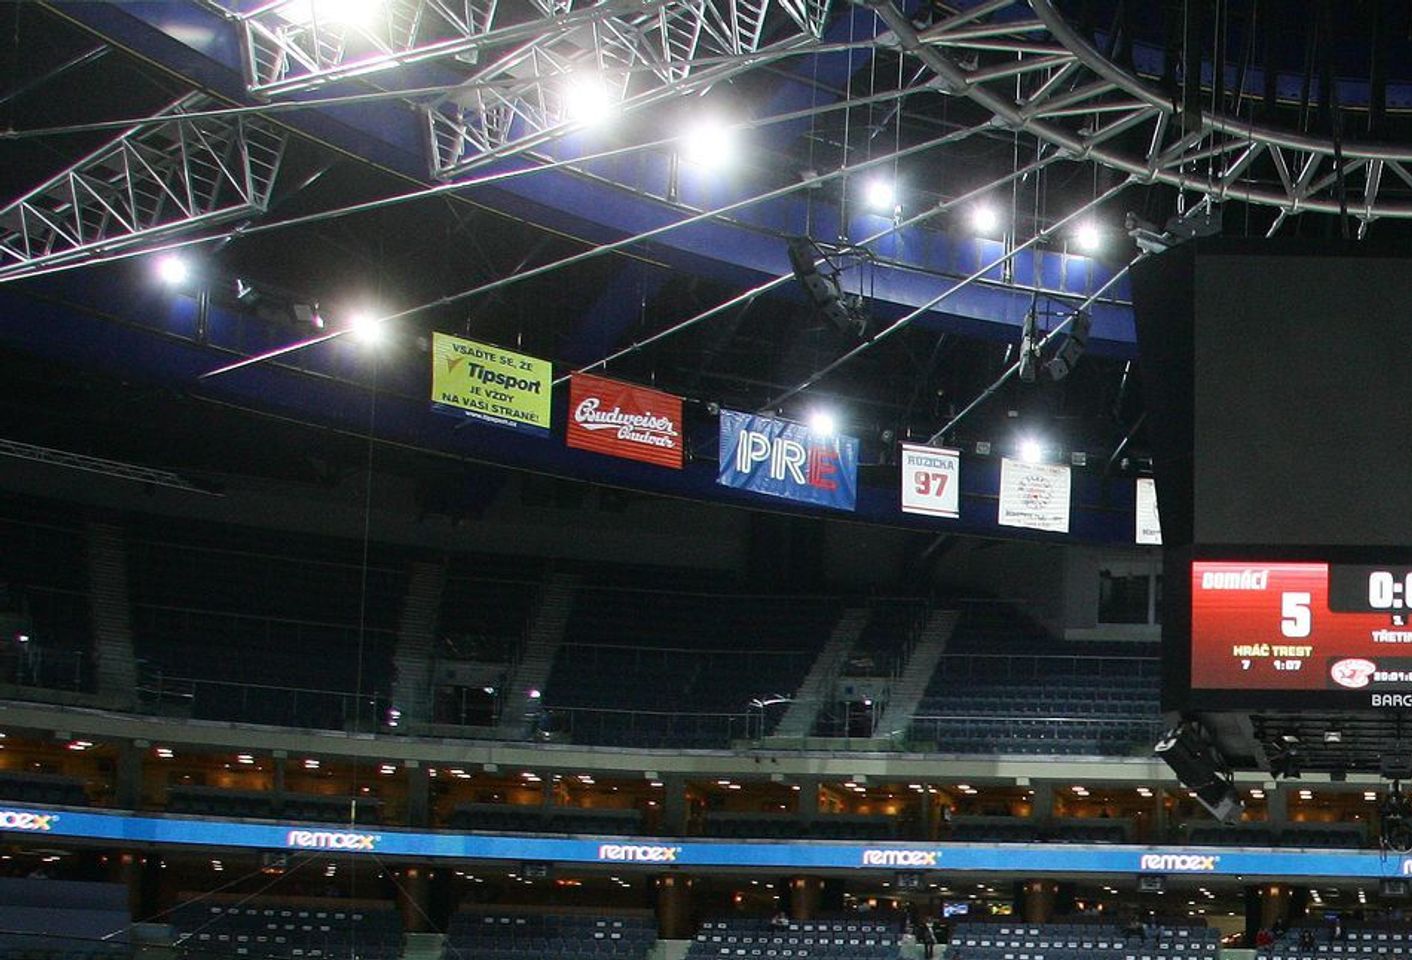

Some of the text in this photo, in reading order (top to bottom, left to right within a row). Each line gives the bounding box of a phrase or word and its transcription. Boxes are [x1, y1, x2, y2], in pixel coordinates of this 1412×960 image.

[468, 362, 541, 394] Tipsport
[442, 392, 460, 404] NA
[574, 397, 680, 434] Budweiser
[617, 425, 676, 449] Budvar
[735, 428, 839, 491] PRE
[914, 472, 948, 497] 97
[1281, 591, 1312, 637] 5
[1233, 643, 1312, 657] HRÁČ TREST
[0, 812, 51, 831] oex
